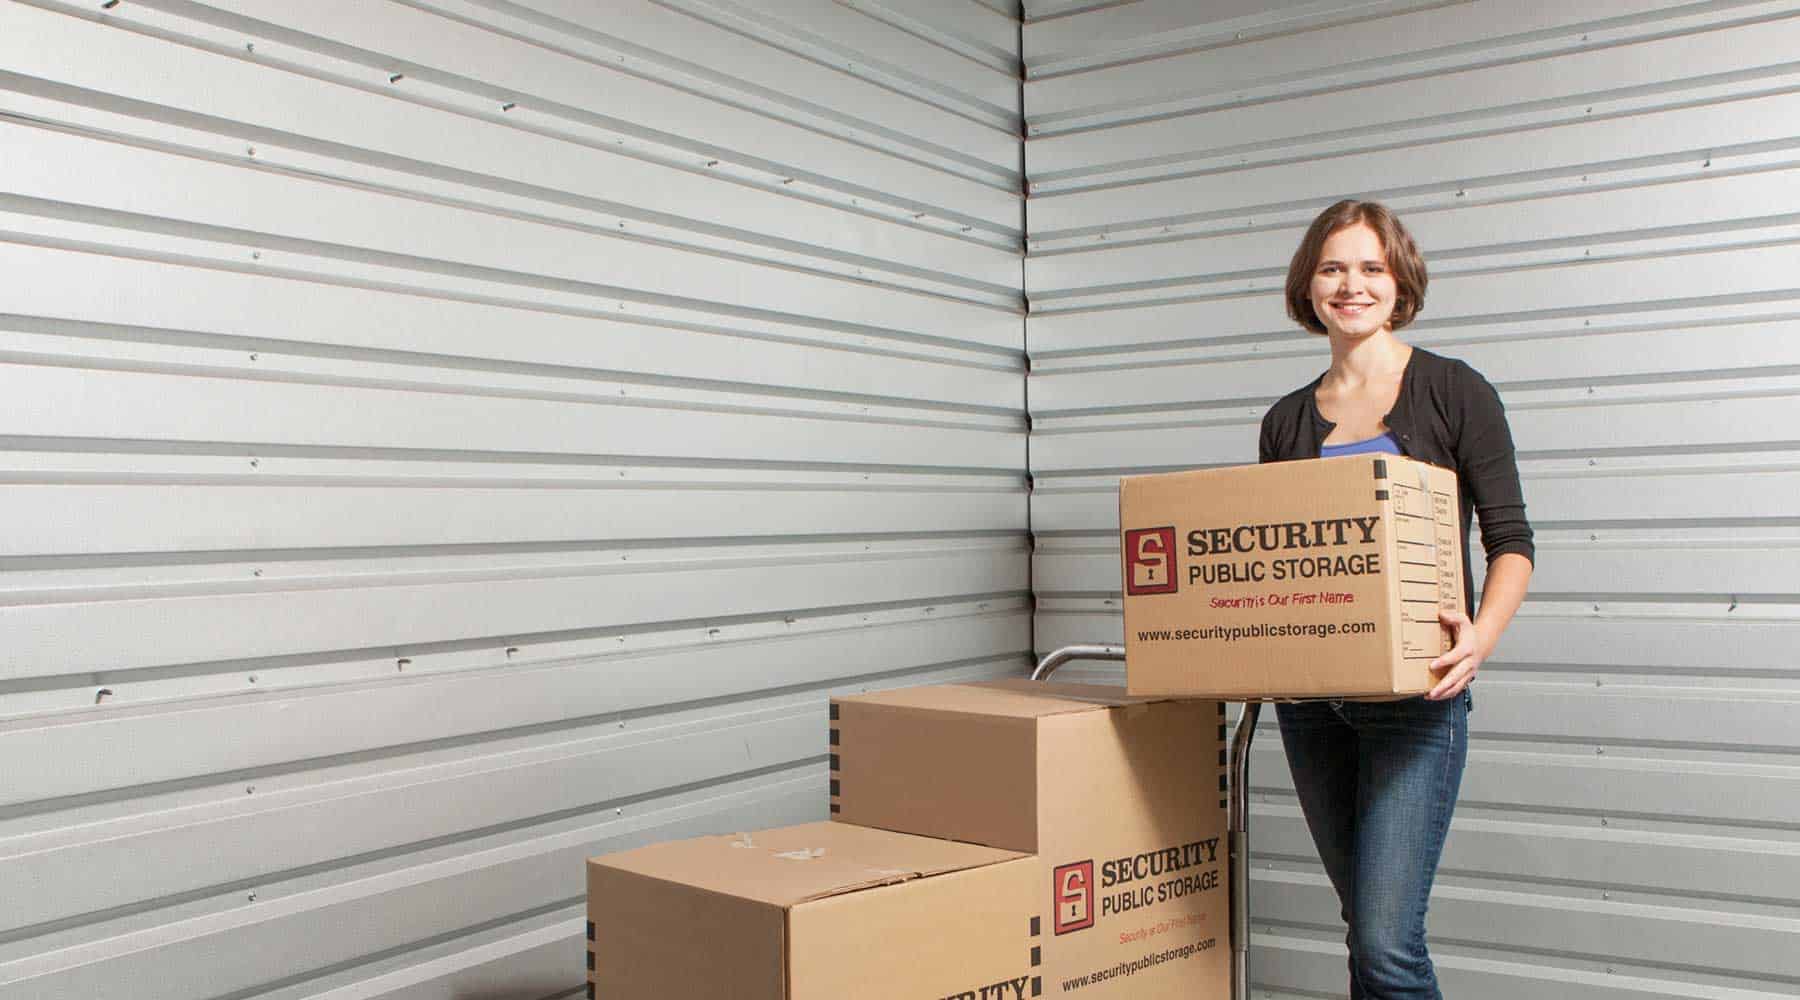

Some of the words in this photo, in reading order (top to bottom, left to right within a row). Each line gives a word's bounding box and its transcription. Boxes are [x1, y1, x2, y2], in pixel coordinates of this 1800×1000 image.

[1187, 516, 1380, 556] SECURITY
[1189, 561, 1265, 585] PUBLIC
[1273, 554, 1380, 580] STORAGE
[1268, 593, 1289, 606] Our
[1292, 592, 1316, 604] First
[1319, 591, 1354, 604] Name
[1138, 621, 1376, 643] www.securitypublicstorage.com
[1101, 837, 1220, 888] SECURITY
[1102, 889, 1154, 917] PUBLIC
[1158, 870, 1218, 902] STORAGE
[1119, 927, 1148, 945] Security
[1062, 937, 1216, 992] www.securitypublicstorage.com
